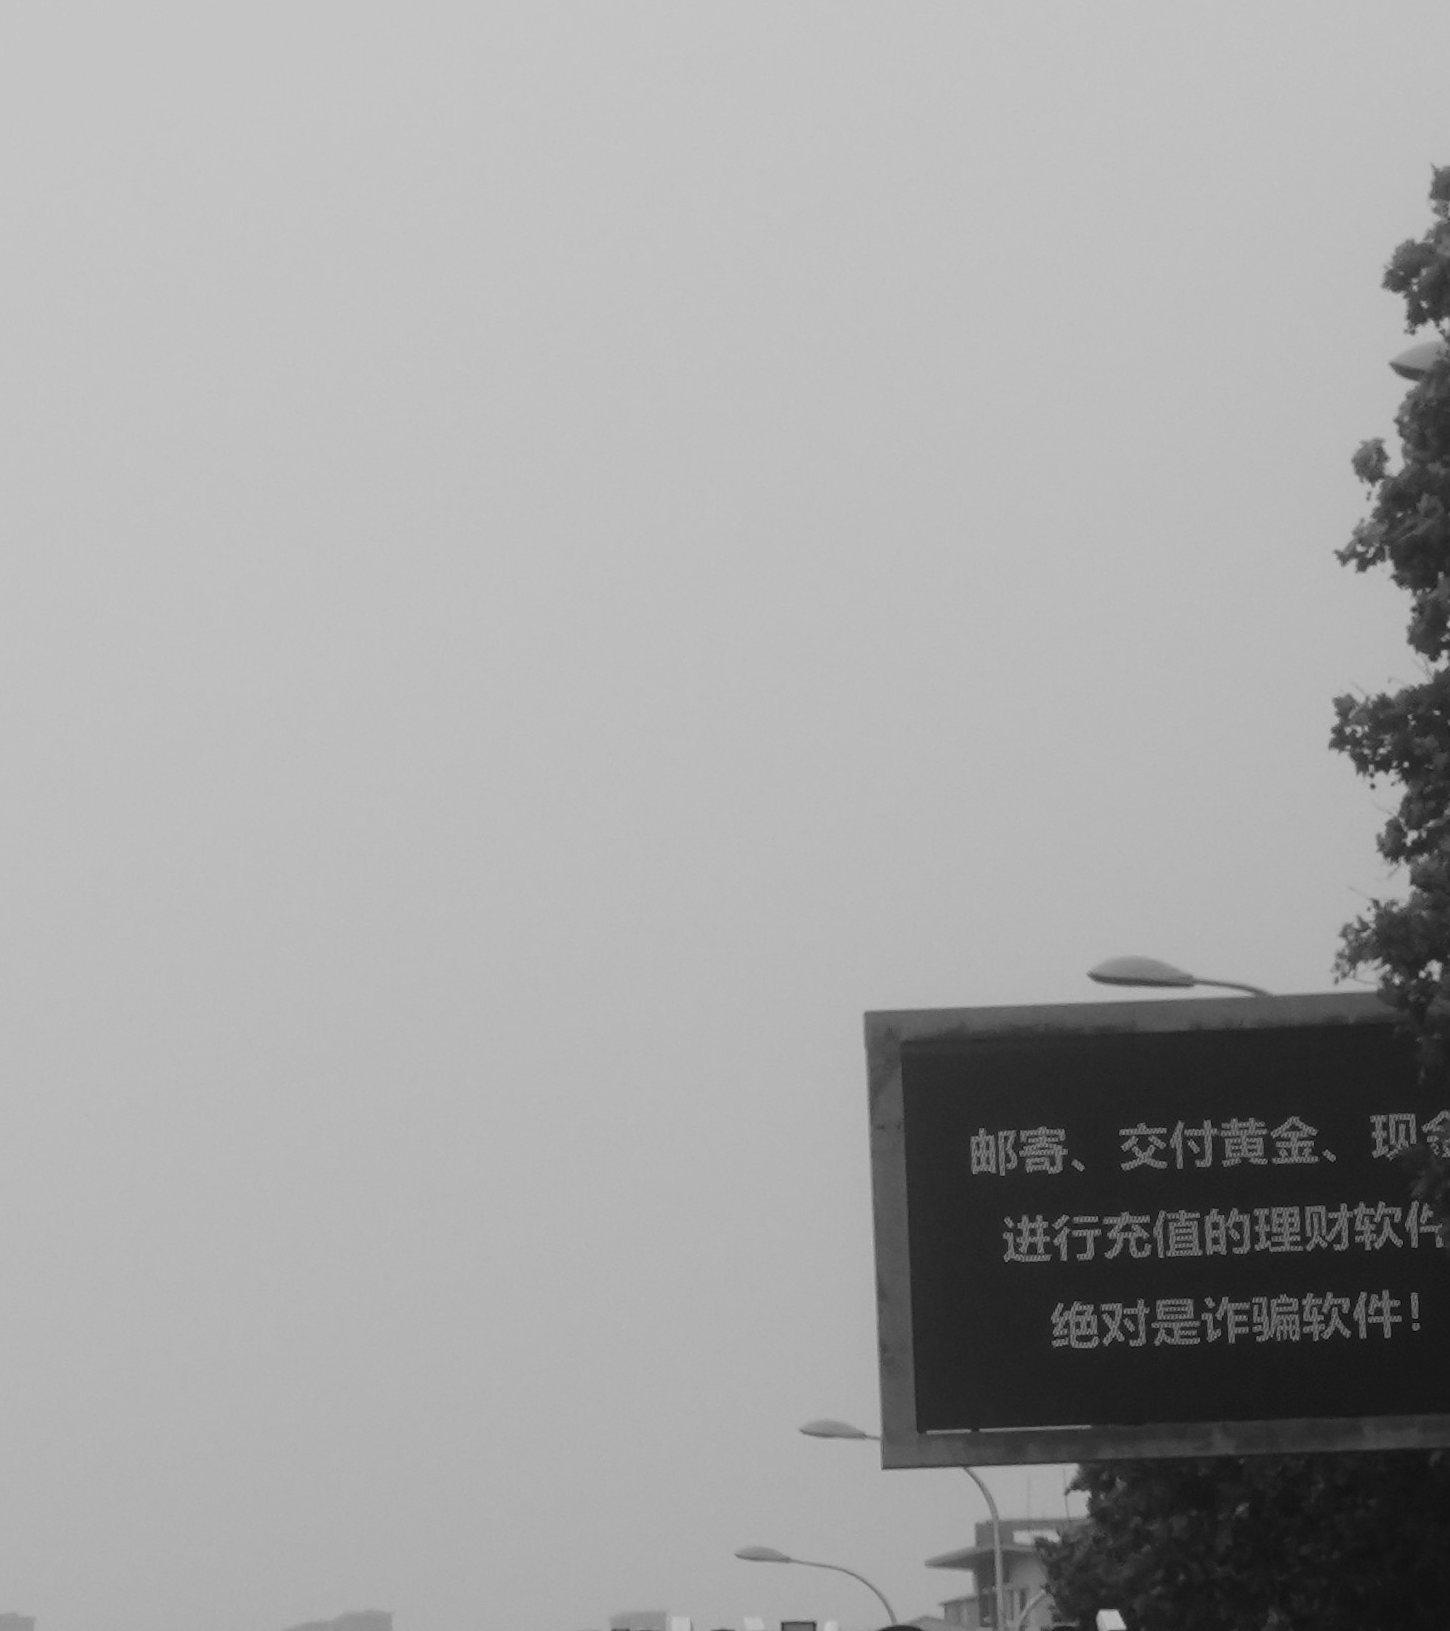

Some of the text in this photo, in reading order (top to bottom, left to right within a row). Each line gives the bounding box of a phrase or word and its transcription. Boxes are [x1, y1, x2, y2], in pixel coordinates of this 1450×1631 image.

[1002, 1200, 1445, 1263] 进行充值的理财软件
[1050, 1289, 1422, 1349] 绝对是诈骗软件！
